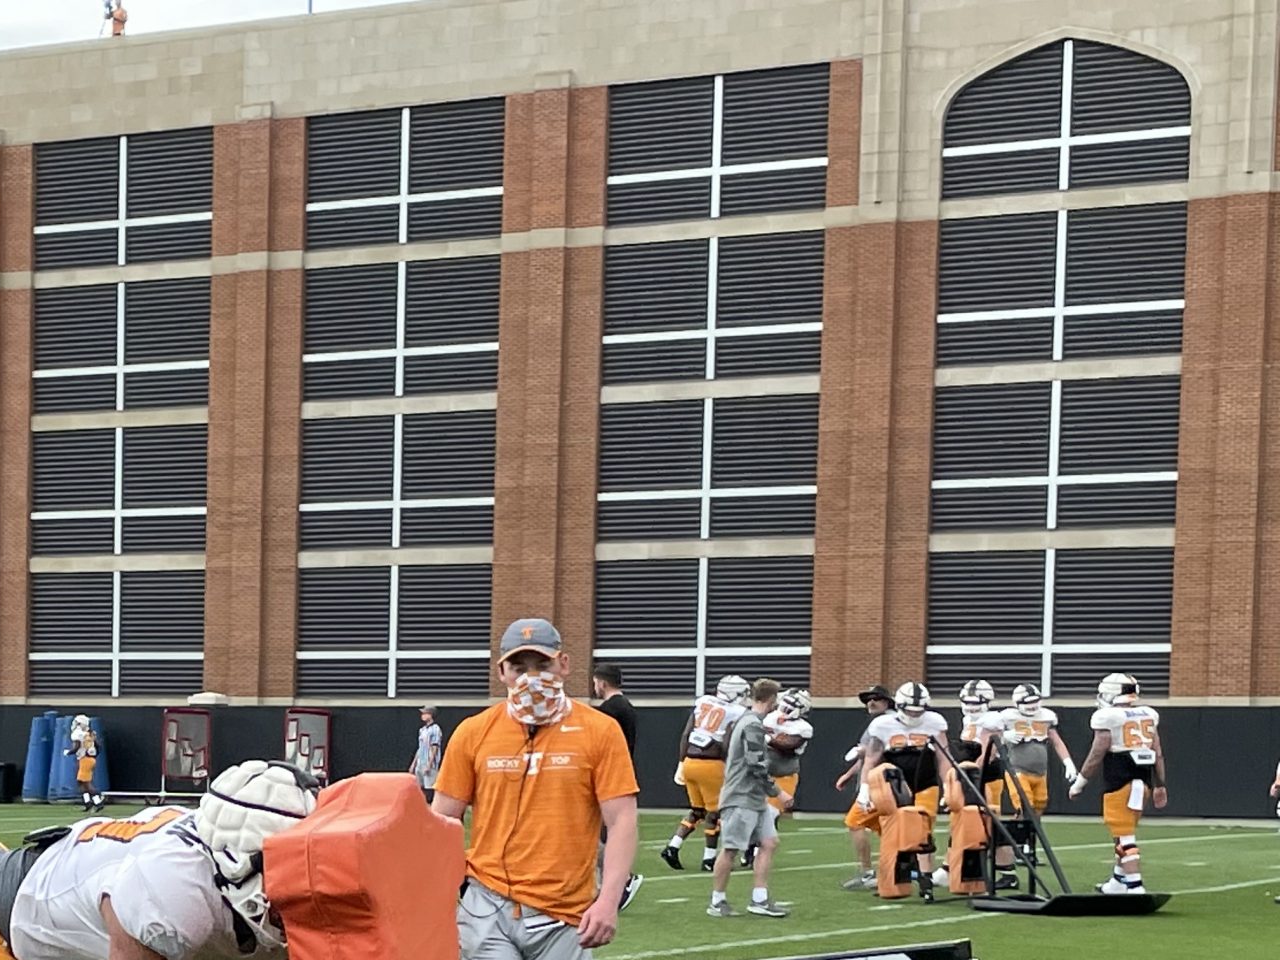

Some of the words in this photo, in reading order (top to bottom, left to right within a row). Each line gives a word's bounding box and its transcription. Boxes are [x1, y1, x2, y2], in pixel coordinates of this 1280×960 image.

[695, 703, 726, 732] 70
[1123, 719, 1154, 748] 65
[522, 752, 543, 775] T
[550, 756, 571, 765] TOP
